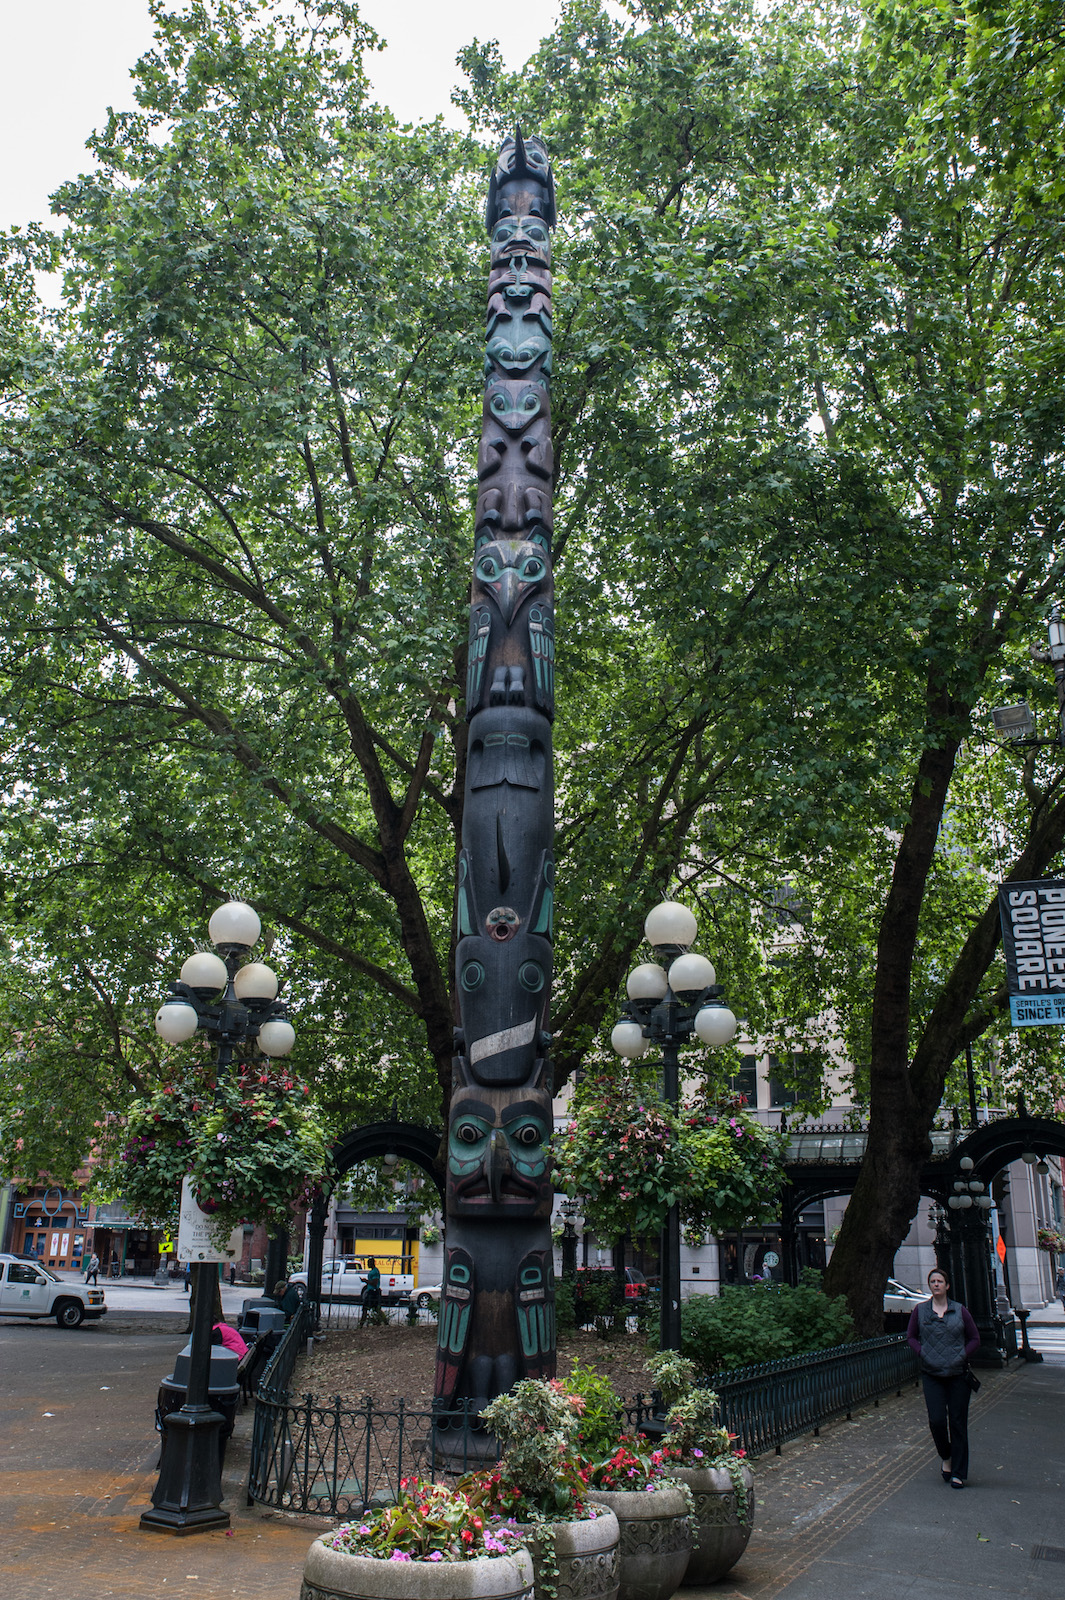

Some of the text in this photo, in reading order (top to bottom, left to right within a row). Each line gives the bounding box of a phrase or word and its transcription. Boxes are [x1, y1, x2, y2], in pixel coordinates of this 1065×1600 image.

[1009, 891, 1048, 990] SQUARE
[1038, 888, 1065, 989] PIONEER
[1016, 999, 1052, 1008] SEATTLE'S
[1017, 1007, 1053, 1021] SINCE
